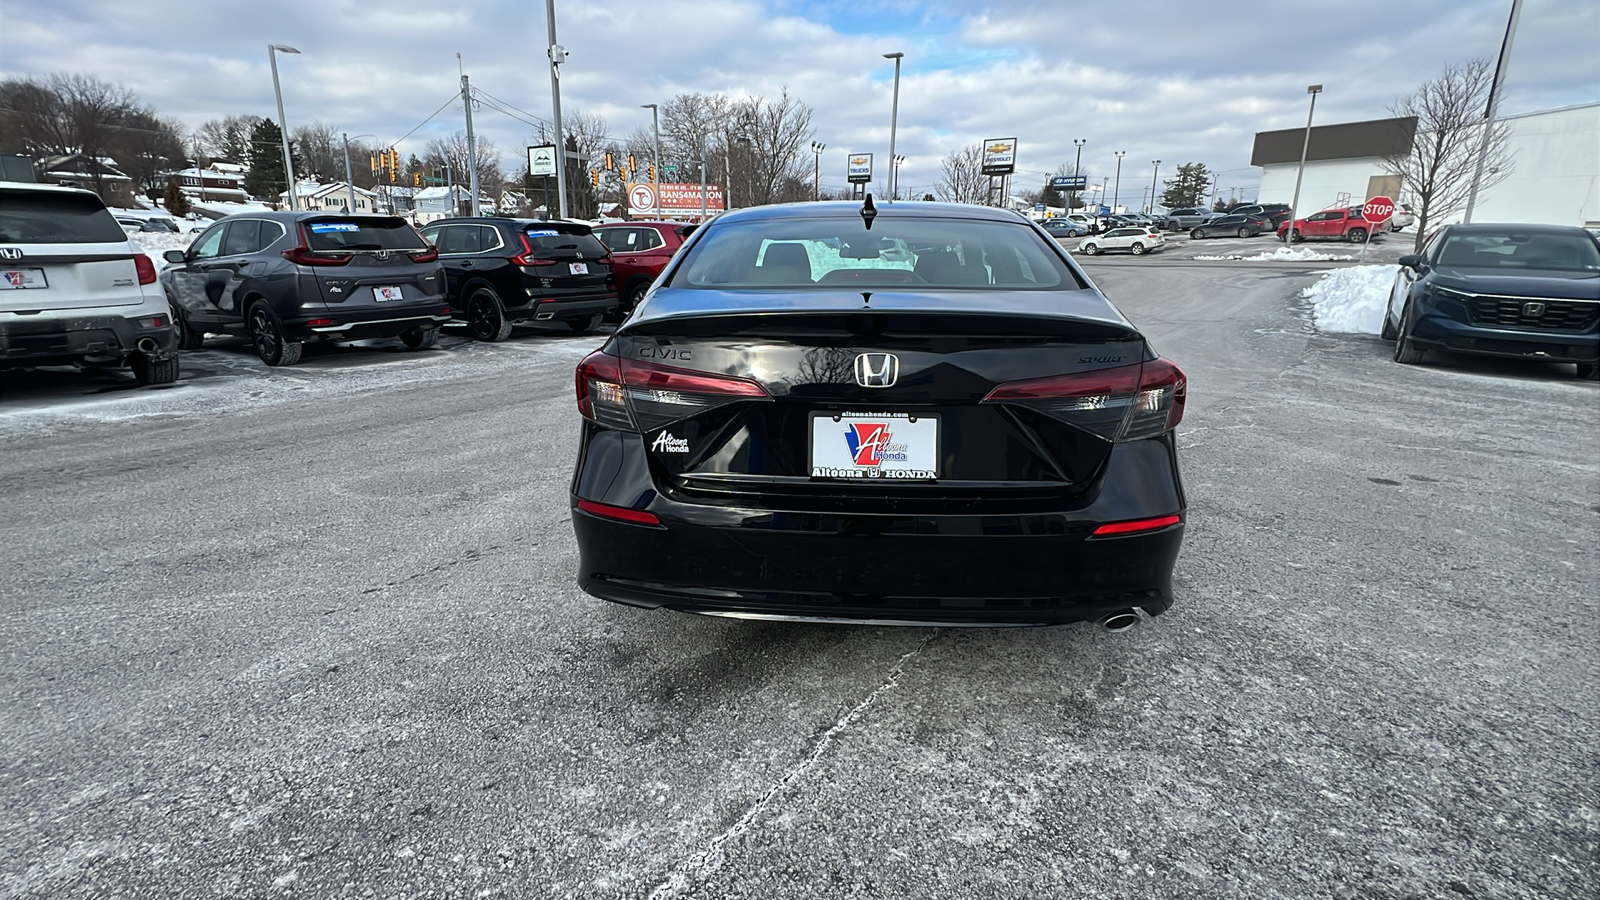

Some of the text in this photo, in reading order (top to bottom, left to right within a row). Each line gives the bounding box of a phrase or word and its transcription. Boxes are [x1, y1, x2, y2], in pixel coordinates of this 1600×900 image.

[659, 191, 722, 199] RANS4MAION
[1364, 204, 1393, 215] STOP
[639, 348, 692, 360] CIVIC
[1077, 356, 1126, 364] SPORT
[876, 451, 906, 460] Honda
[812, 467, 937, 479] Altoona HONDA
